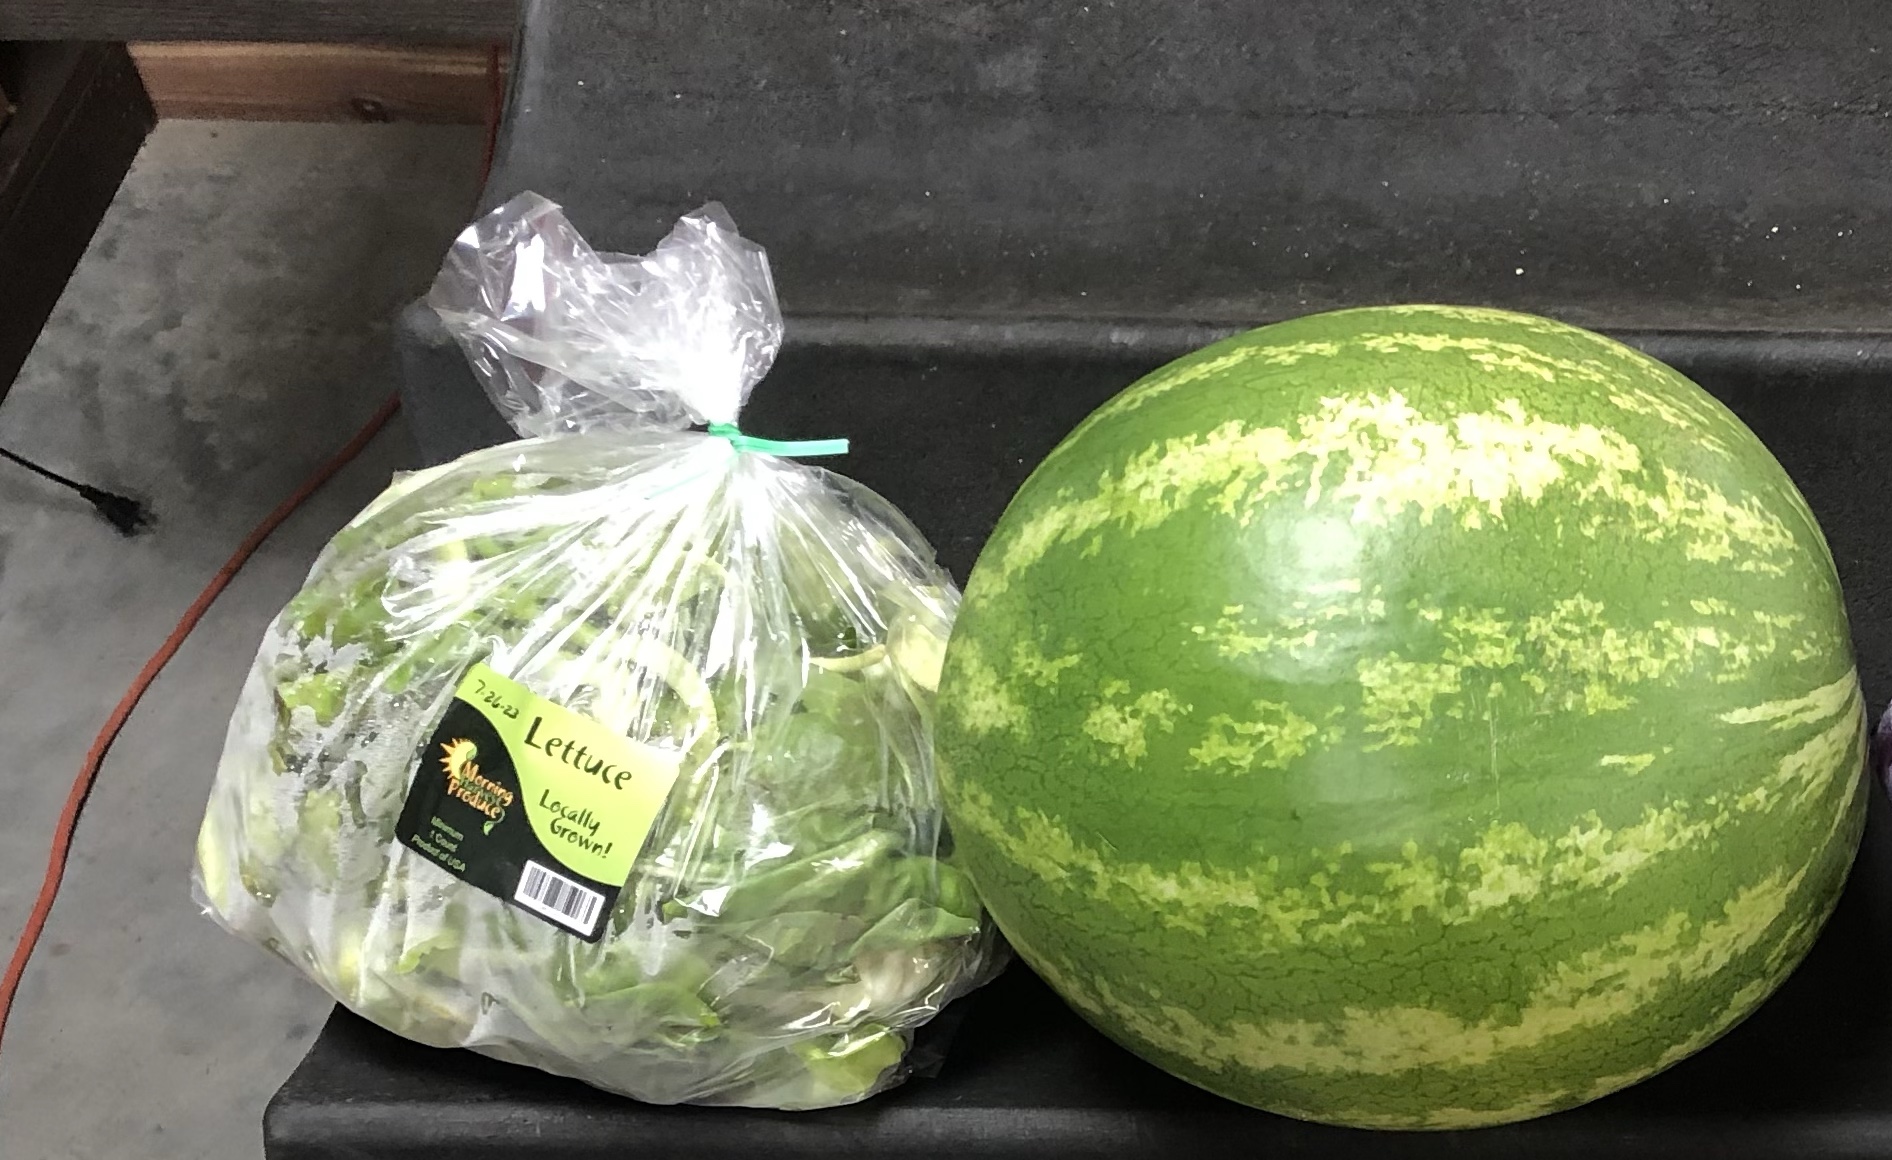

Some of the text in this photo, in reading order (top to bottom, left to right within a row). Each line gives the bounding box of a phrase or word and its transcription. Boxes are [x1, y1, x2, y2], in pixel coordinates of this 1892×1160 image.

[524, 716, 632, 790] Lettuce
[447, 779, 501, 819] Produce
[462, 761, 513, 807] Morning
[539, 789, 600, 837] Locally
[550, 818, 613, 859] Grown!
